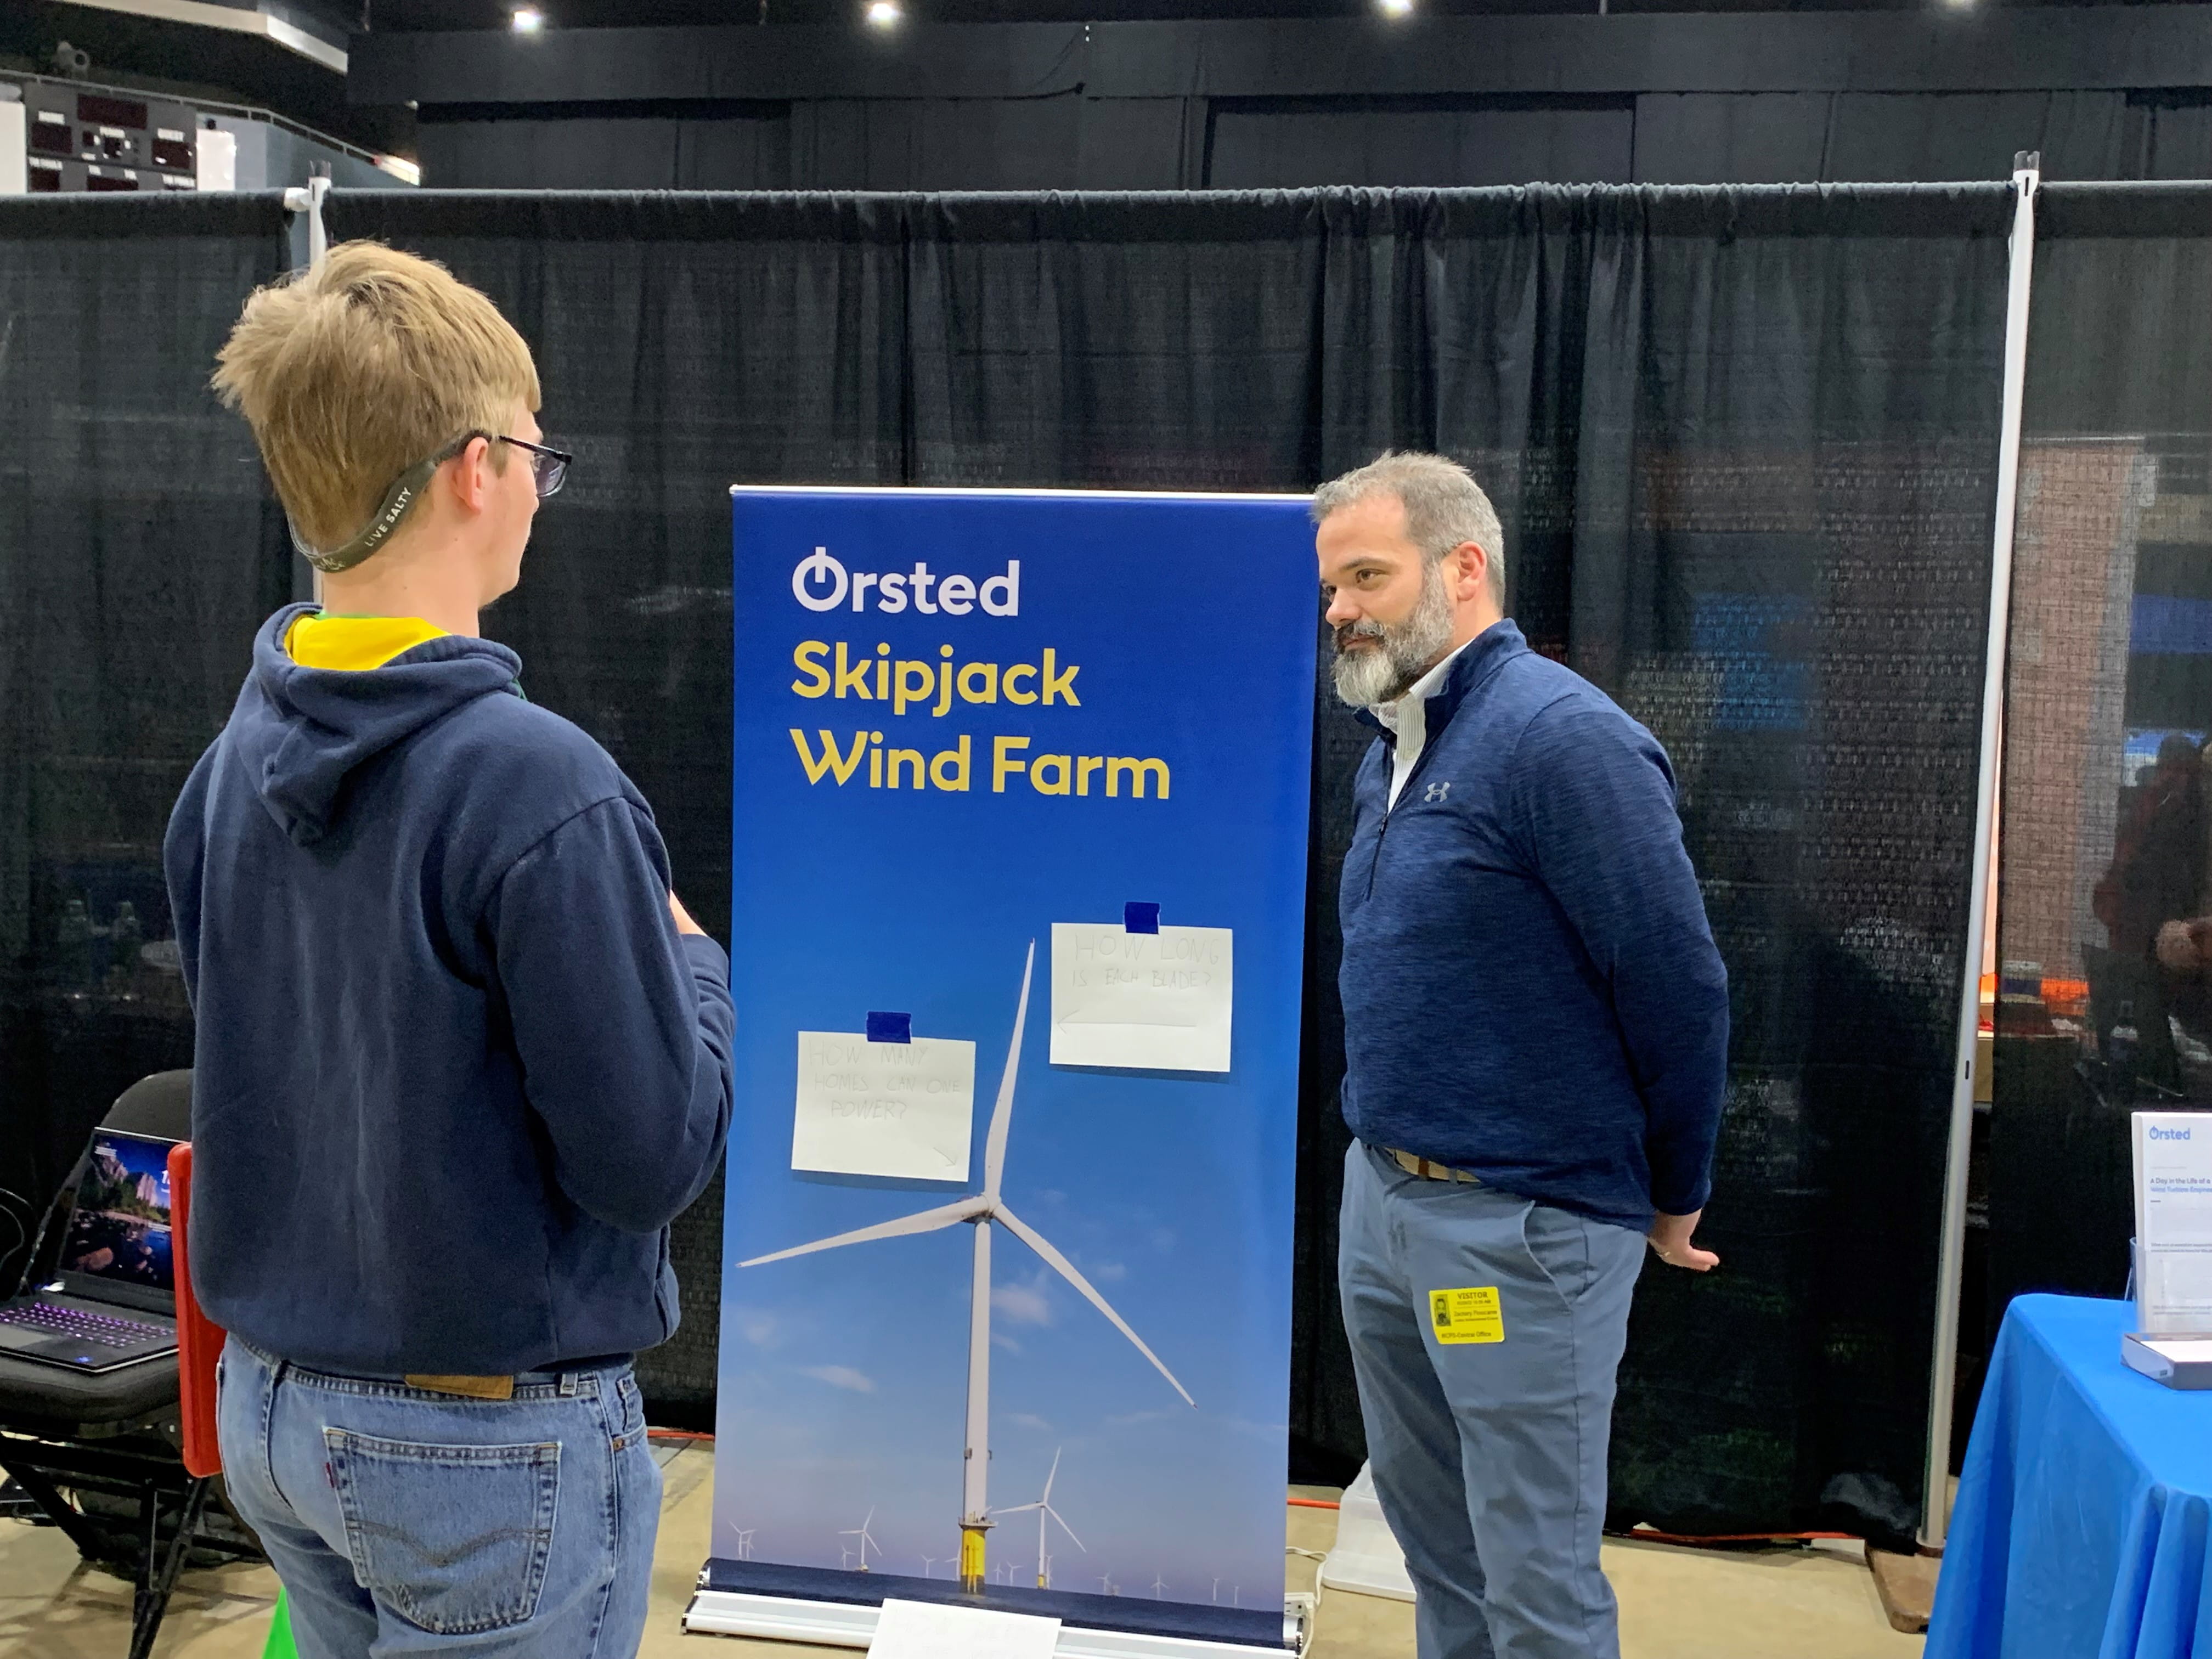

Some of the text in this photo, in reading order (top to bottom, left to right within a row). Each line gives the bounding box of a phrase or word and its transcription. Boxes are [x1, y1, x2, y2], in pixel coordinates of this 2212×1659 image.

[364, 487, 411, 547] LIVE SALTY
[791, 640, 1081, 717] Skipjack
[789, 729, 1170, 799] Wind Farm
[1075, 934, 1221, 965] HOW LONG
[1073, 968, 1212, 990] IS EACH BLADE?
[808, 1036, 929, 1067] HOW MANY
[815, 1072, 962, 1094] HOMES CAN ONE
[831, 1098, 908, 1120] POWER?
[1457, 1291, 1488, 1300] VISITOR
